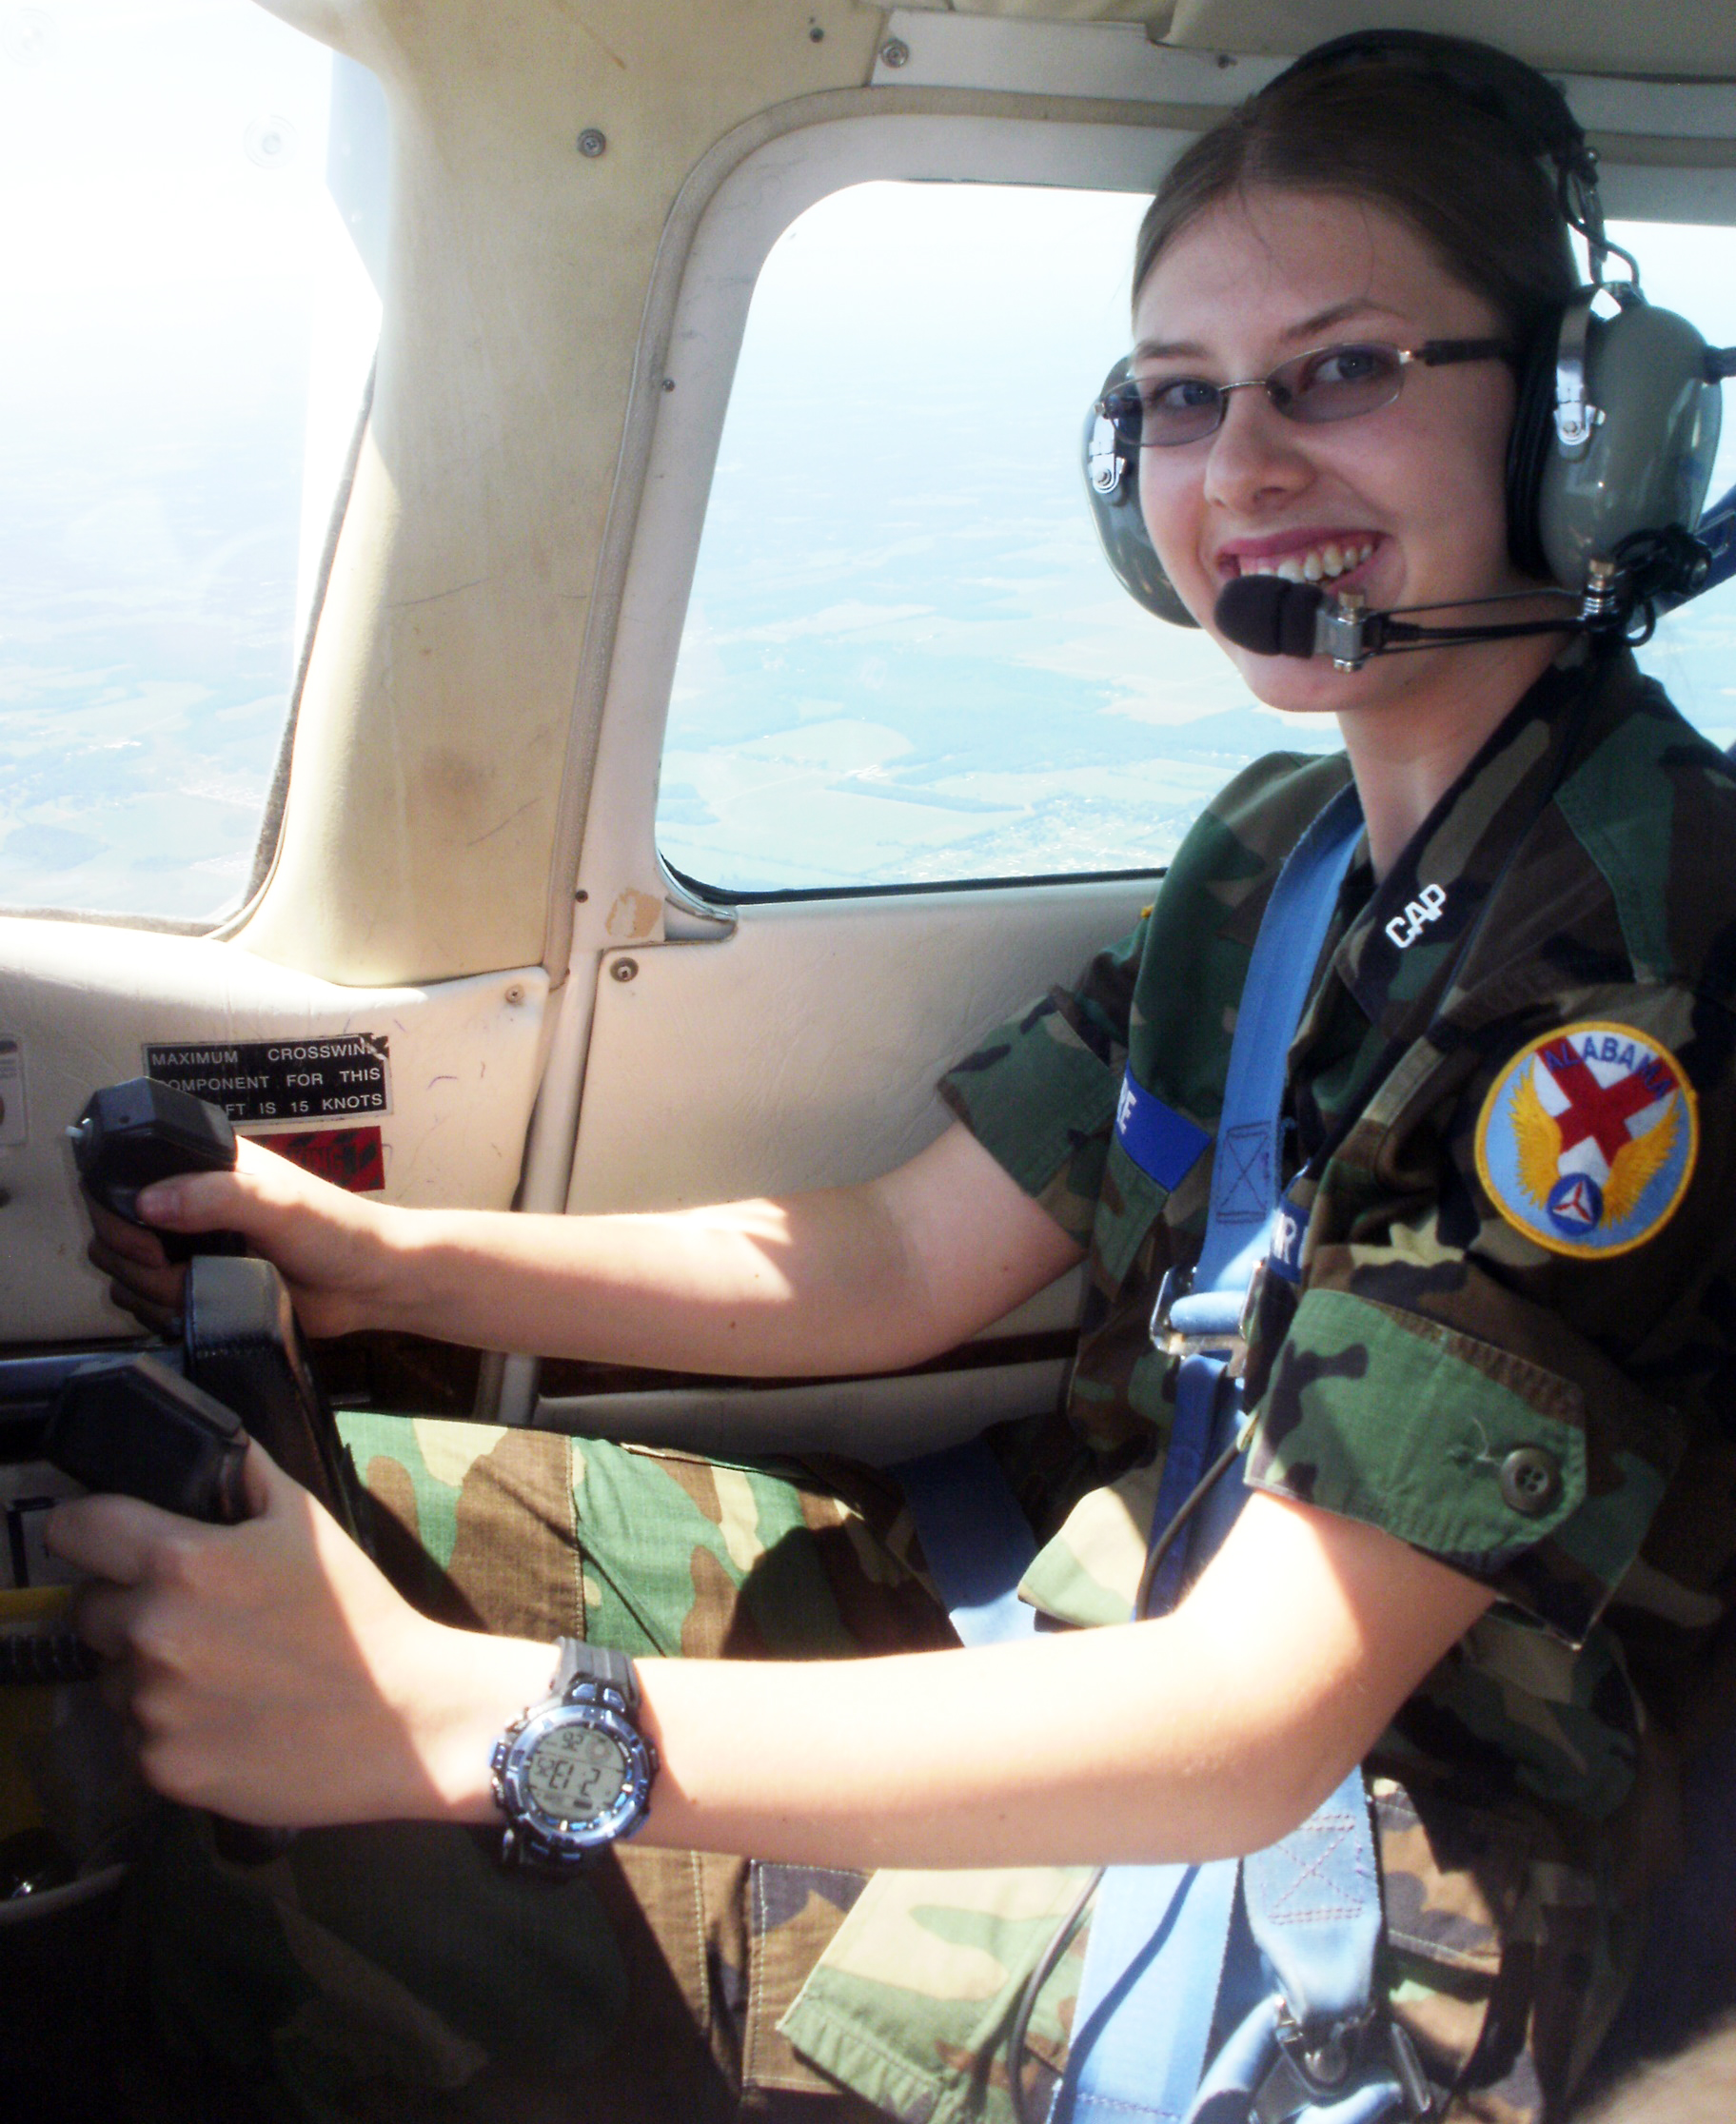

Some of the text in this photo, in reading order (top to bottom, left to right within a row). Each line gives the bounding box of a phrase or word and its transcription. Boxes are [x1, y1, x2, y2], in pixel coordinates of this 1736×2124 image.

[1385, 883, 1447, 949] CAP
[151, 1043, 372, 1066] MAXIMUM CROSSWIN
[159, 1067, 381, 1092] OMPONENT FOR THIS
[1544, 1035, 1673, 1100] ALABAMA
[260, 1101, 277, 1115] IS
[291, 1100, 309, 1112] 15
[322, 1092, 383, 1111] KNOTS
